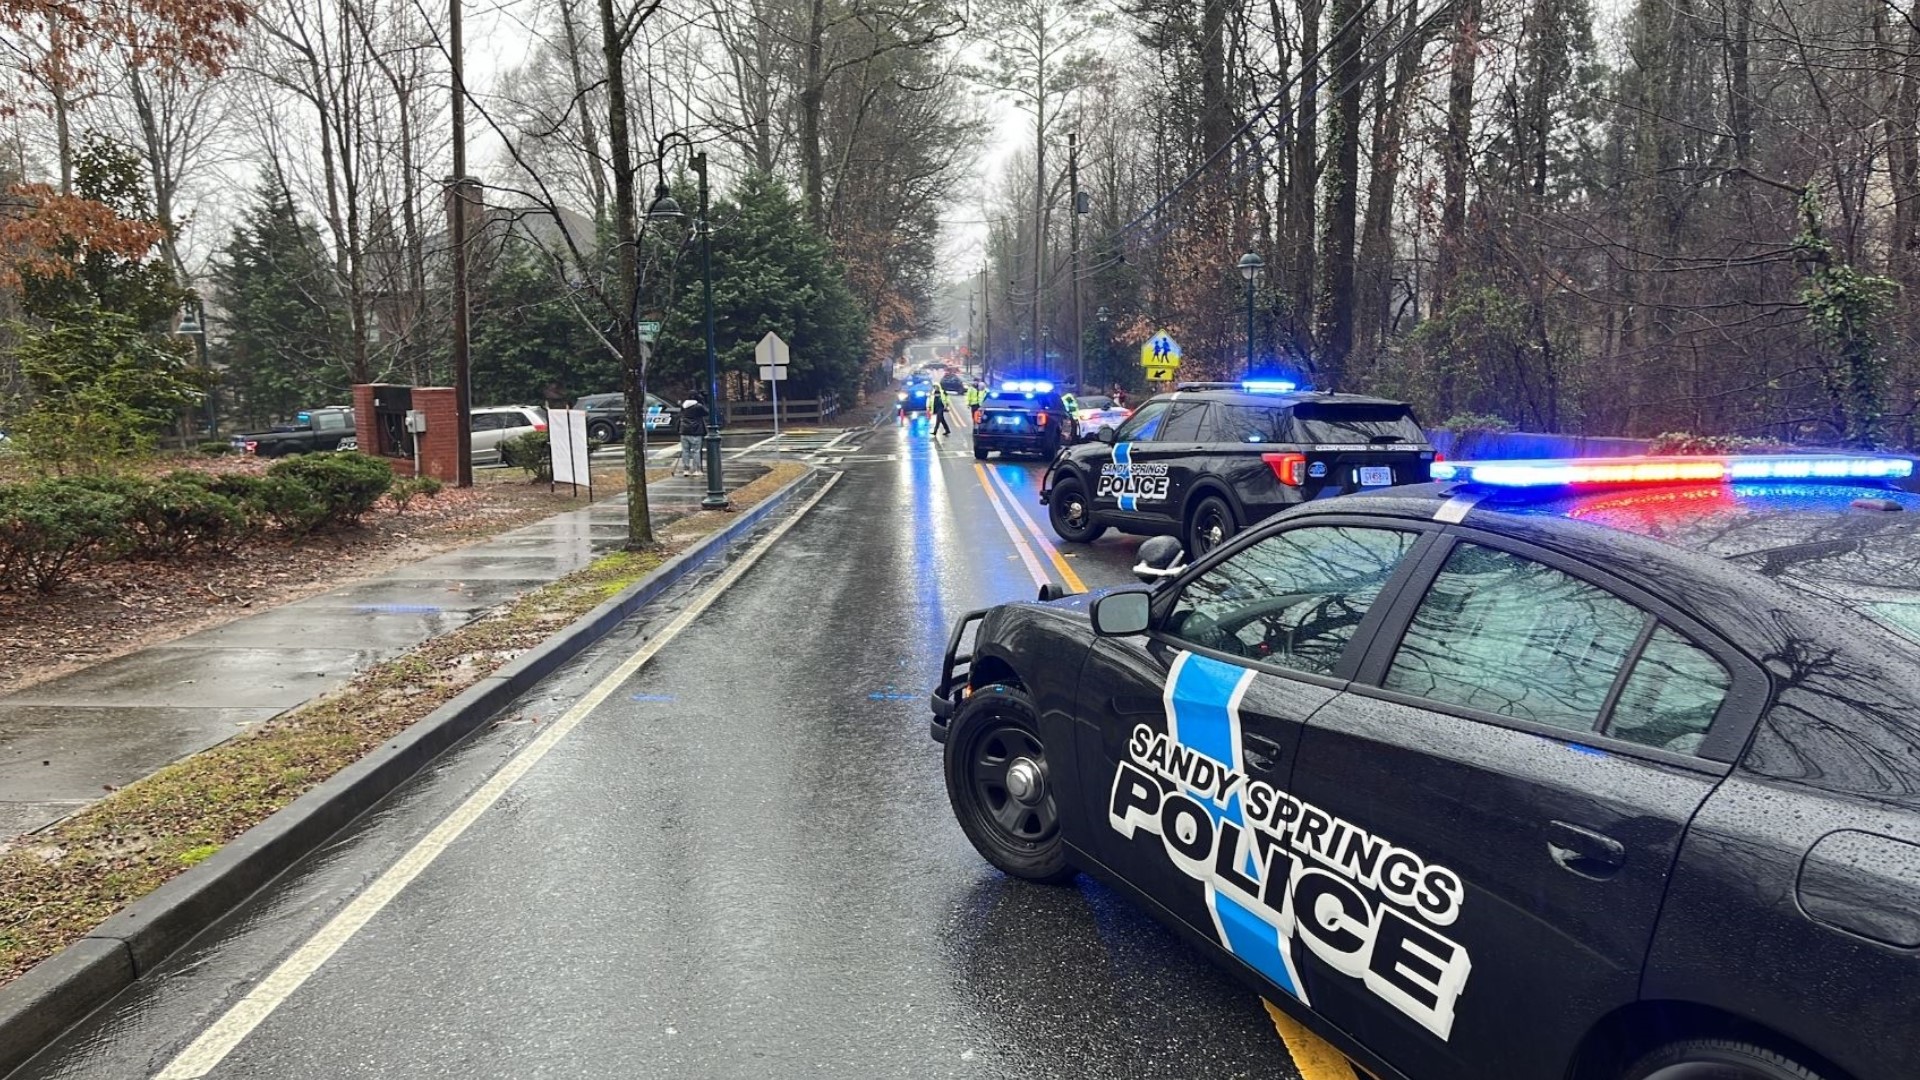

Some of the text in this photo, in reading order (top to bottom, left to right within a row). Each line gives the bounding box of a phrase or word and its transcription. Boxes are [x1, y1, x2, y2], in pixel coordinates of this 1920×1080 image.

[1097, 476, 1170, 499] POLICE
[1101, 463, 1168, 476] SANDY SPRINGS
[1131, 724, 1463, 926] SANDY SPRINGS
[1109, 761, 1472, 1041] POLICE
